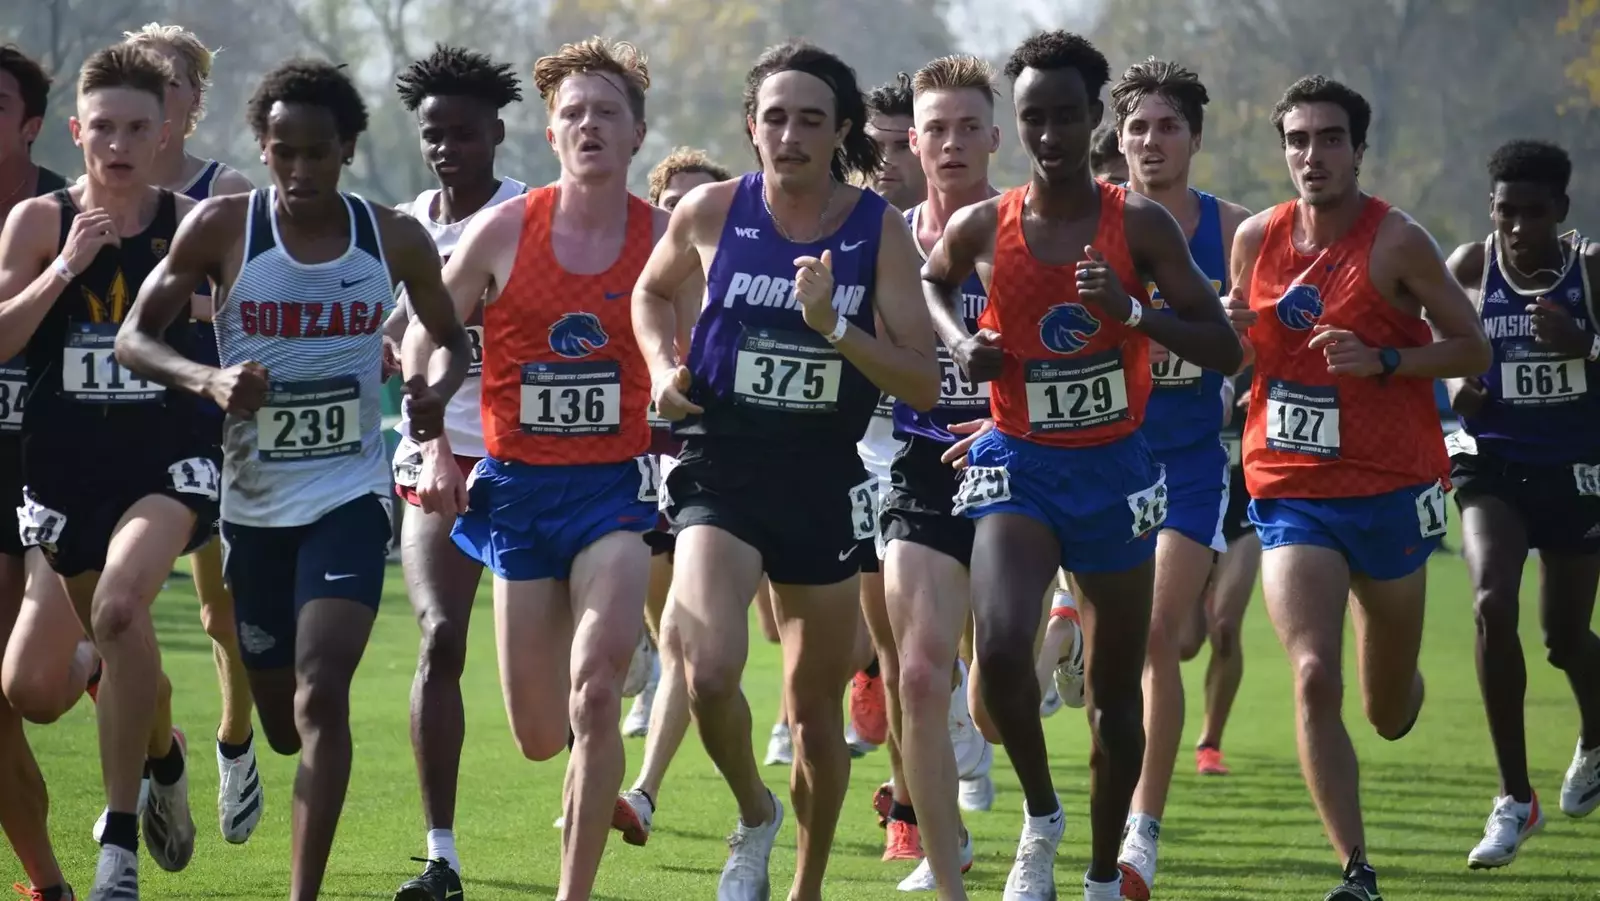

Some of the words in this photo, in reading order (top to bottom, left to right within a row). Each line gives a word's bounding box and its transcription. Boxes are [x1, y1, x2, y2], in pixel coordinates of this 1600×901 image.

[735, 227, 760, 239] WCC
[723, 272, 866, 315] PORTND
[752, 356, 827, 400] 375
[1044, 377, 1113, 418] 129
[1516, 363, 1573, 396] 661
[538, 387, 605, 424] 136
[1278, 405, 1325, 442] 127
[273, 405, 345, 448] 239
